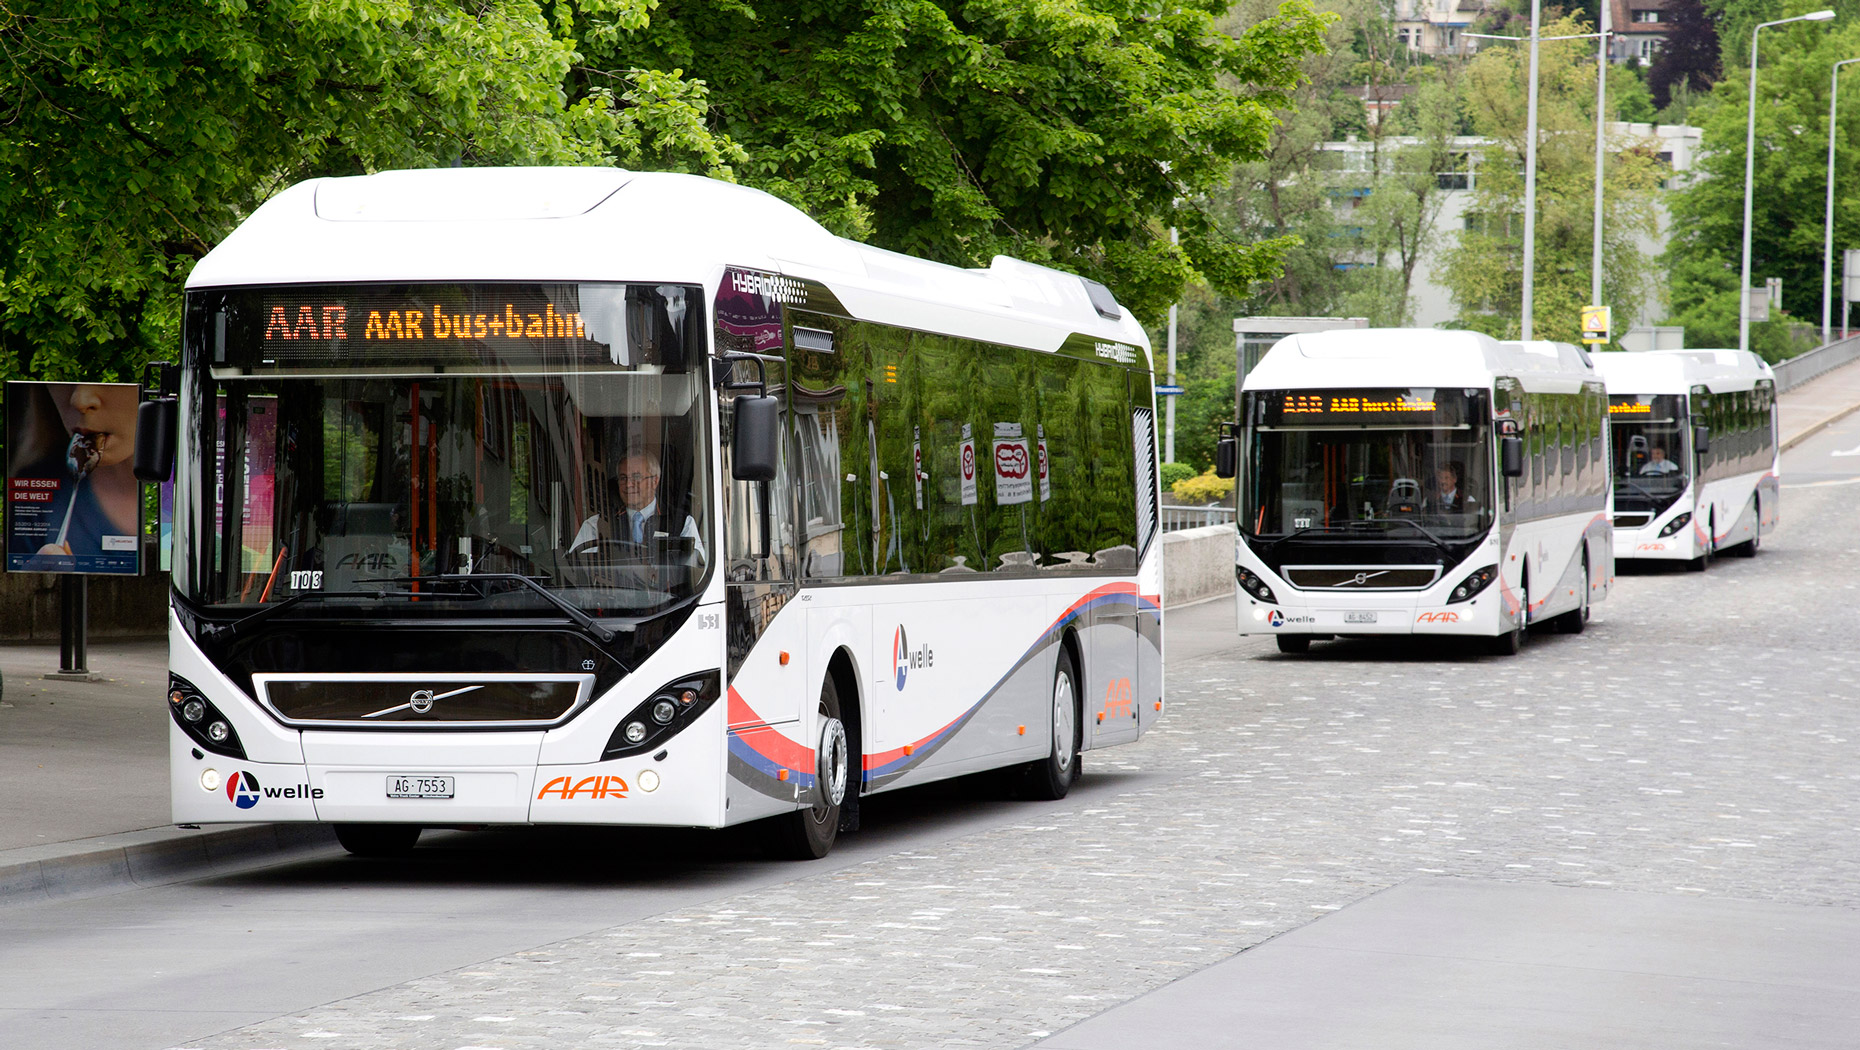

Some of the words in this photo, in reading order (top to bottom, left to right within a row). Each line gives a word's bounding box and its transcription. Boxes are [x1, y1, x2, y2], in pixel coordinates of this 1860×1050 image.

[731, 272, 772, 297] HYBRID
[265, 306, 347, 340] AAR
[365, 310, 424, 340] AAR
[433, 303, 585, 339] bus+bahn
[30, 480, 58, 488] ESSEN
[14, 492, 28, 500] DIE
[29, 492, 50, 500] WELT
[291, 571, 322, 589] 103
[1416, 612, 1459, 623] AAR
[909, 643, 934, 670] welle
[1103, 677, 1133, 720] AAR
[263, 783, 325, 800] welle
[536, 775, 629, 800] AAR
